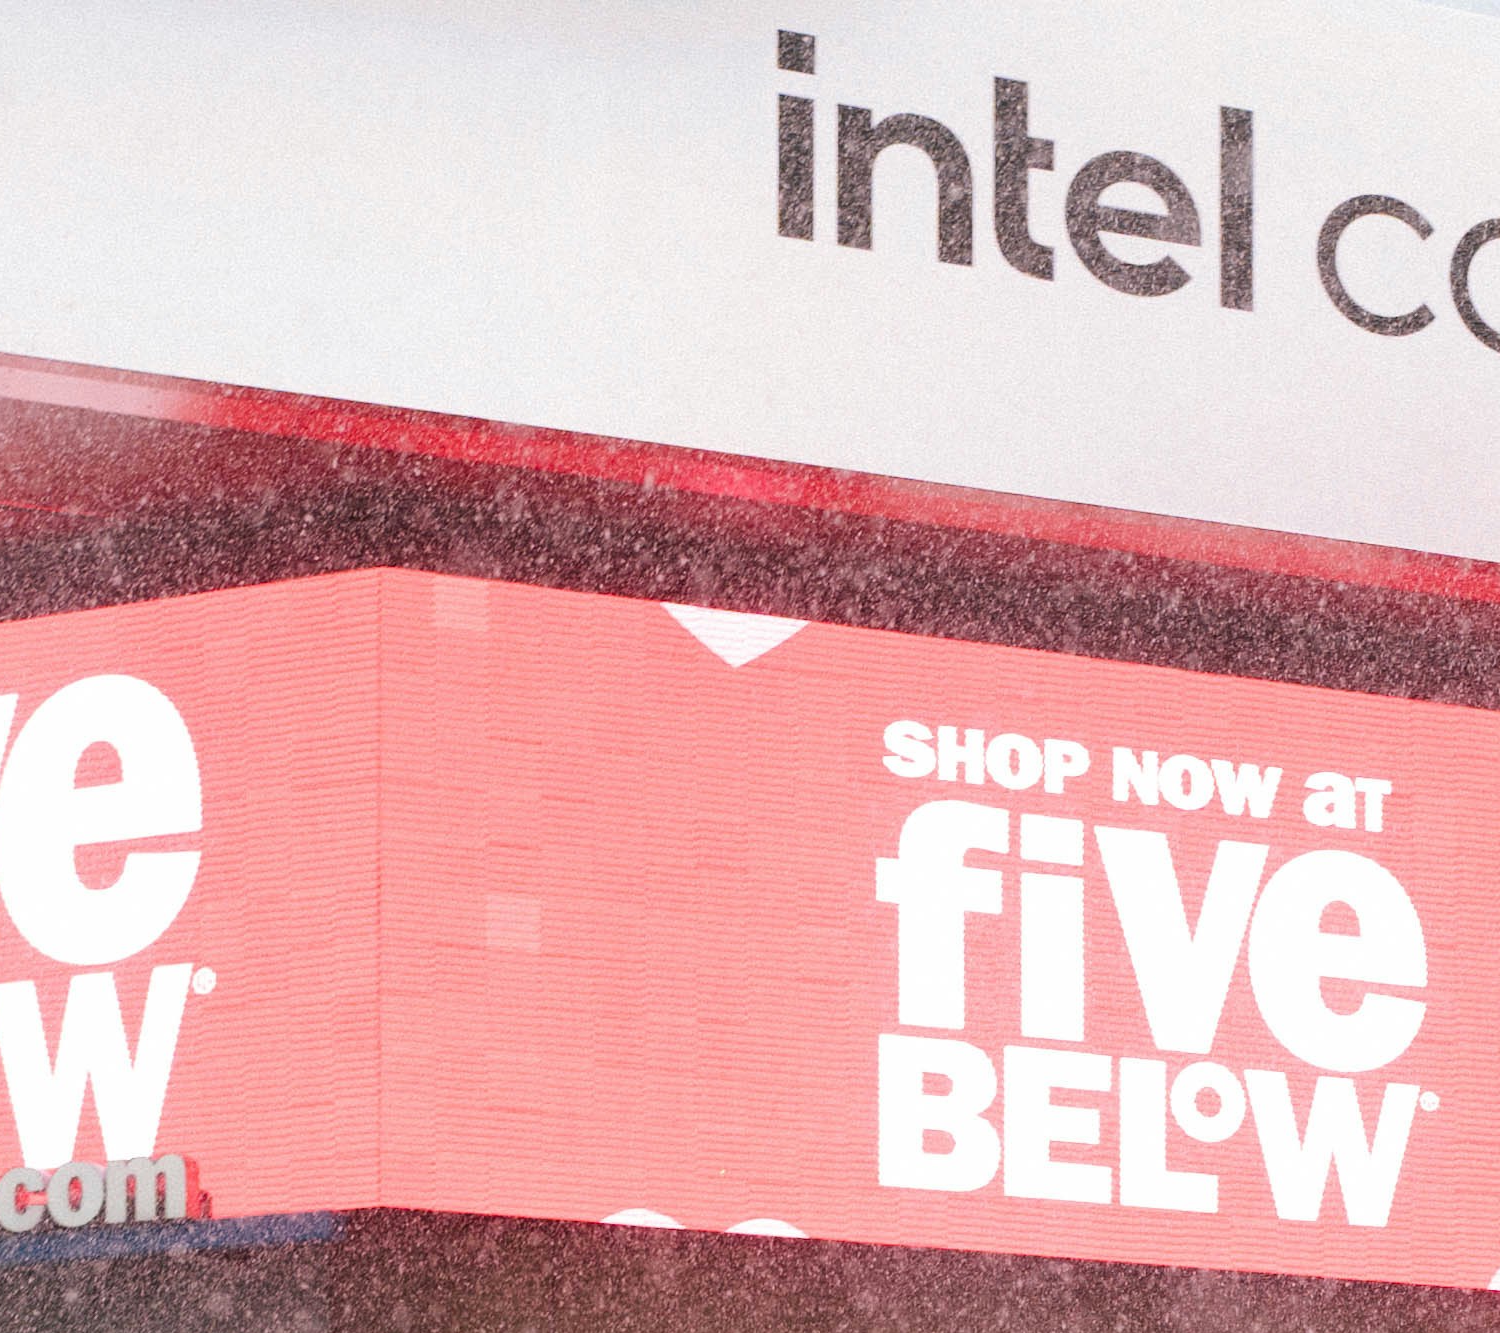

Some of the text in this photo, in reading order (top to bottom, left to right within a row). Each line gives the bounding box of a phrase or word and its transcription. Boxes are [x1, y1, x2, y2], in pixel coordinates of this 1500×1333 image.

[777, 30, 1254, 312] intel
[882, 720, 1090, 794] SHOP
[1113, 746, 1283, 819] NOW
[875, 799, 1428, 1072] five
